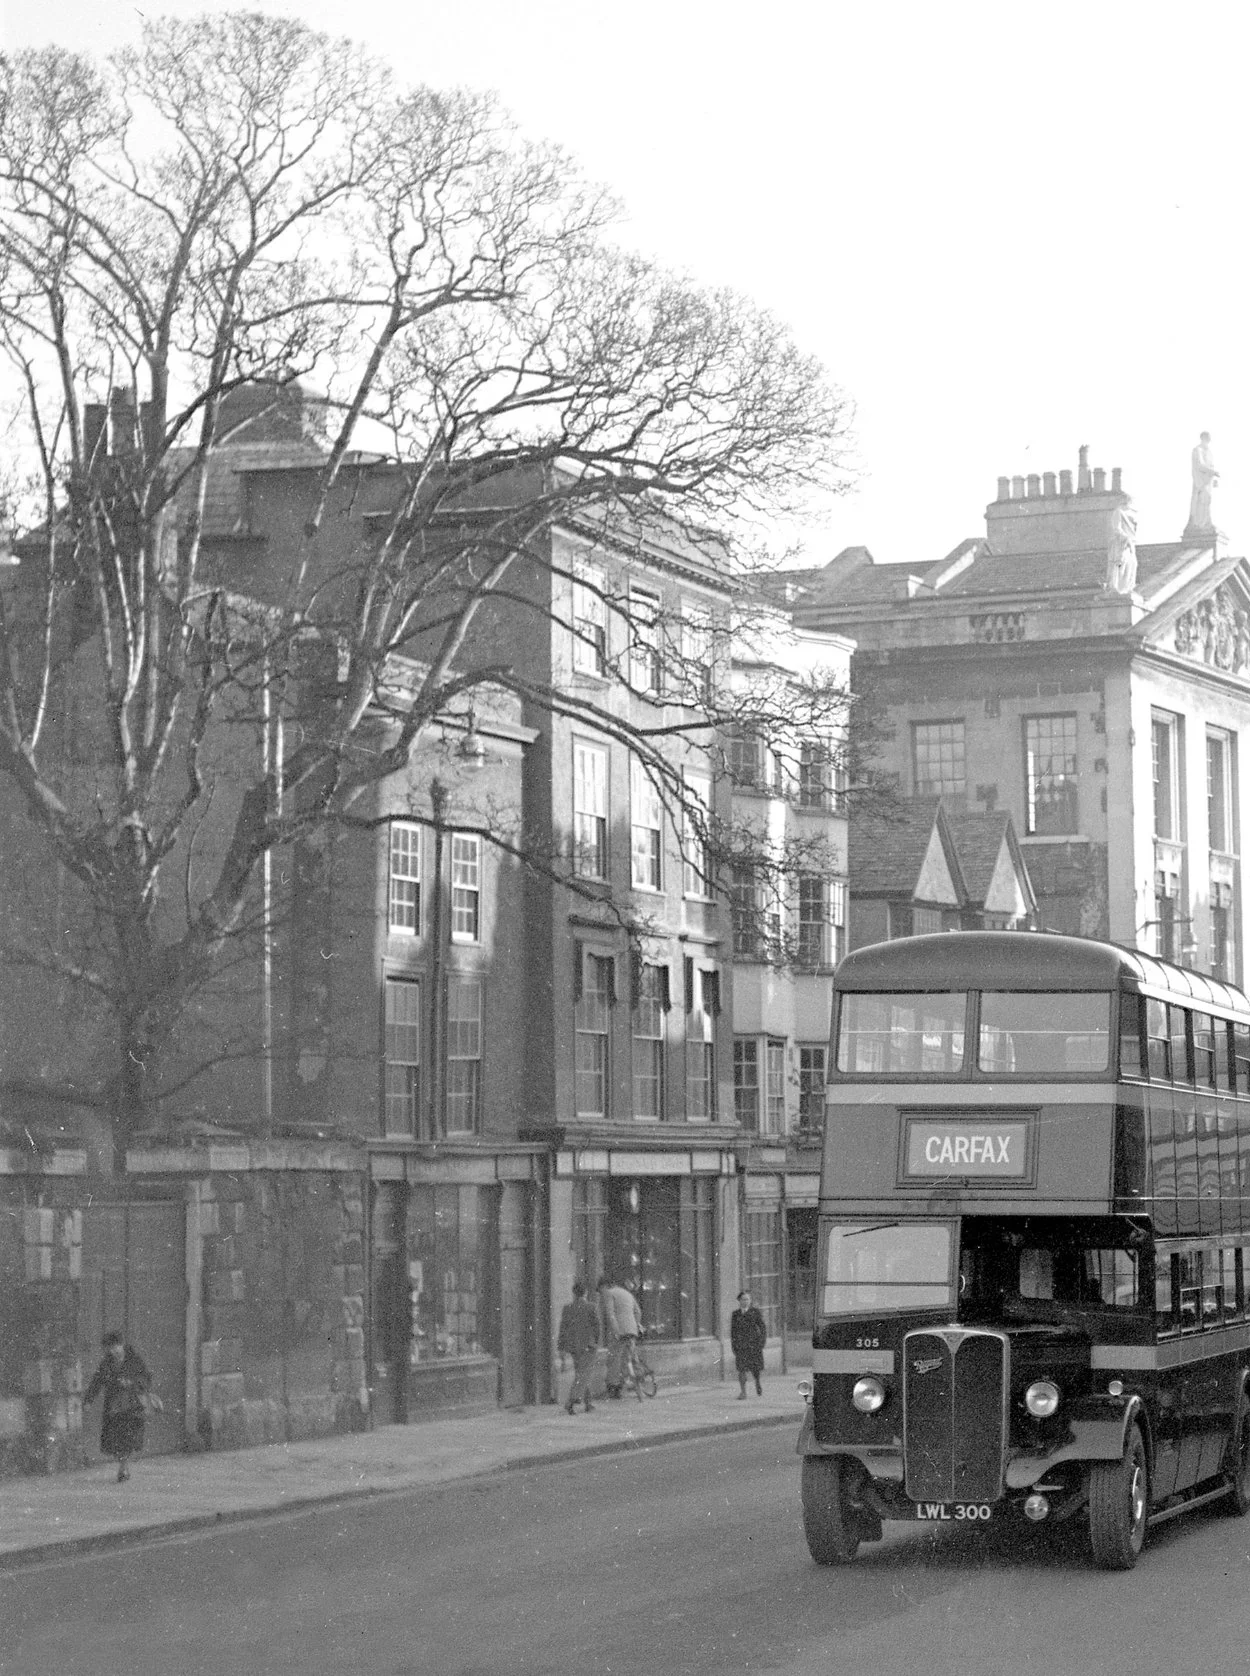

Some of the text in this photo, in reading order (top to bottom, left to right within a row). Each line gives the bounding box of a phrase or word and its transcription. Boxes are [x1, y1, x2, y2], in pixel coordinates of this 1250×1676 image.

[925, 1135, 1011, 1164] CARFAX
[856, 1338, 880, 1348] 305
[917, 1503, 991, 1520] LWL 300
